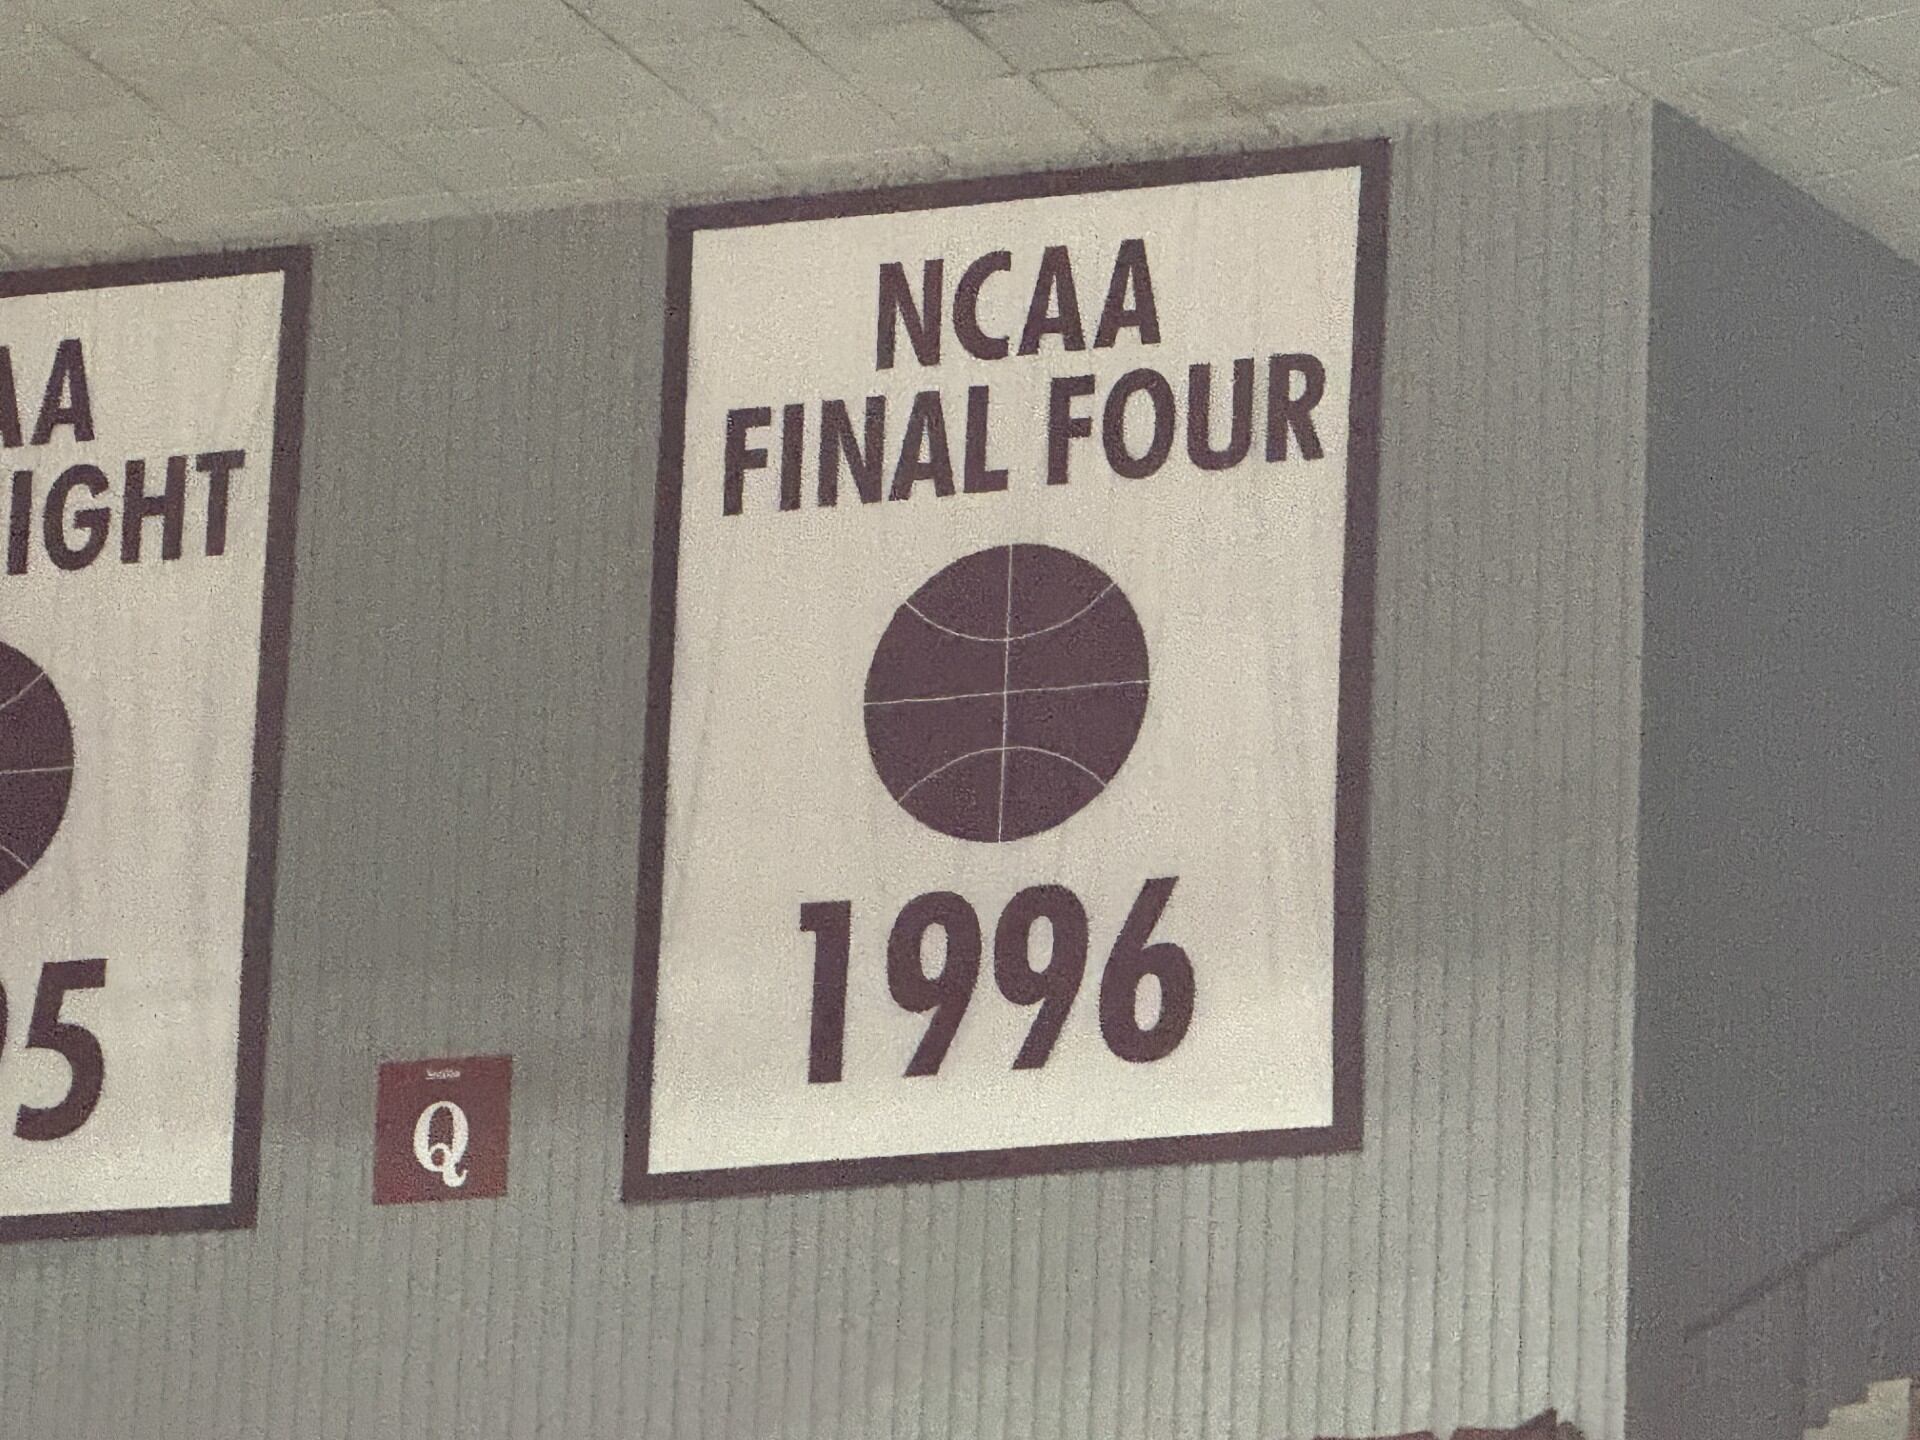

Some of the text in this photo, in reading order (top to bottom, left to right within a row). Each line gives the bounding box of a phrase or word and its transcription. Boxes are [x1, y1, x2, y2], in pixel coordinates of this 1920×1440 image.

[876, 238, 1161, 371] NCAA
[722, 353, 1326, 517] FINAL FOUR
[0, 958, 107, 1142] 5
[800, 876, 1196, 1084] 1996
[413, 1101, 468, 1187] Q
